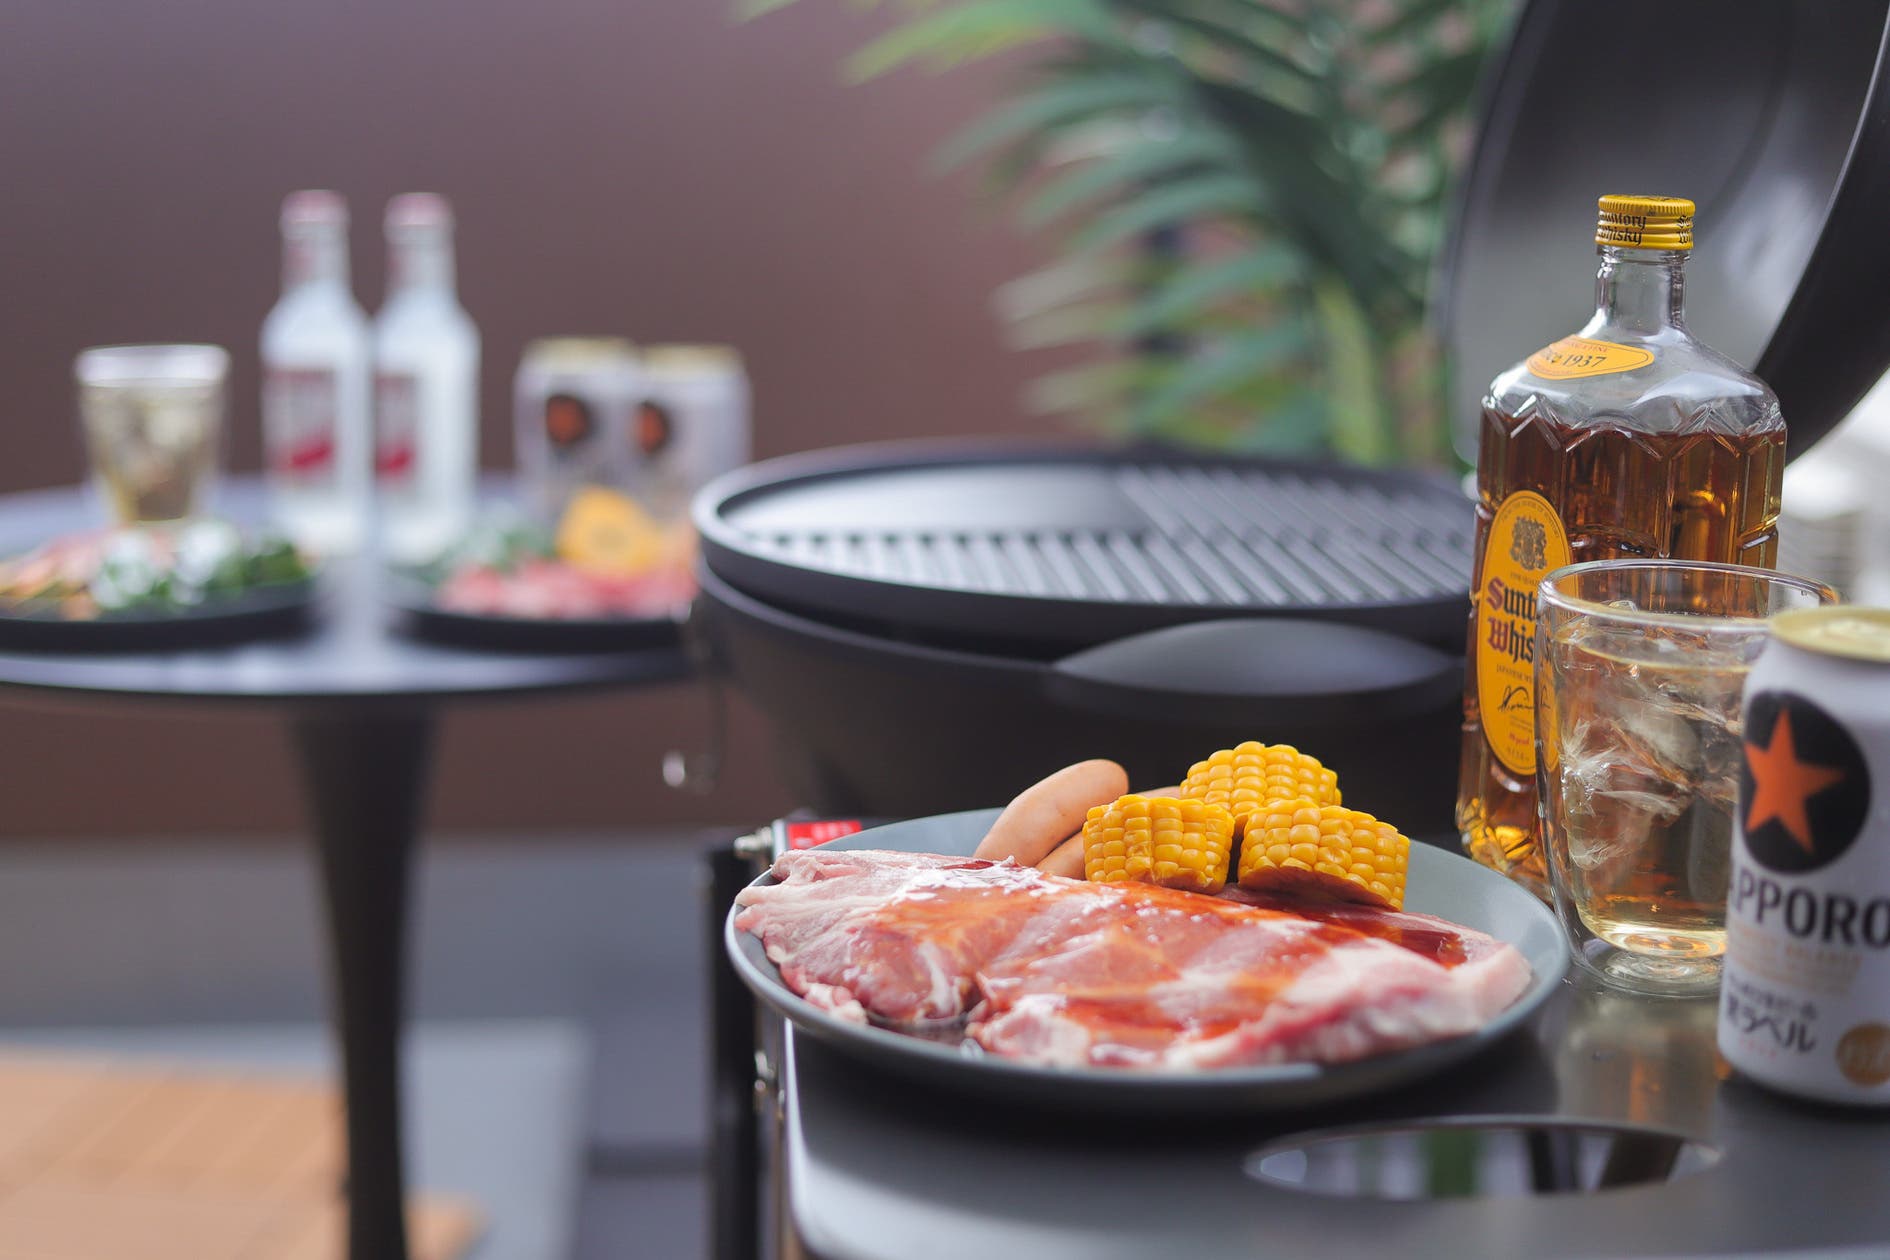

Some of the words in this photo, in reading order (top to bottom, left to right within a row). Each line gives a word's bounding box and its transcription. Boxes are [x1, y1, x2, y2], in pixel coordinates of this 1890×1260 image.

[1562, 354, 1607, 368] 1937
[1486, 577, 1540, 622] Sunt
[1487, 617, 1536, 664] Whis
[1730, 866, 1890, 950] PPORO
